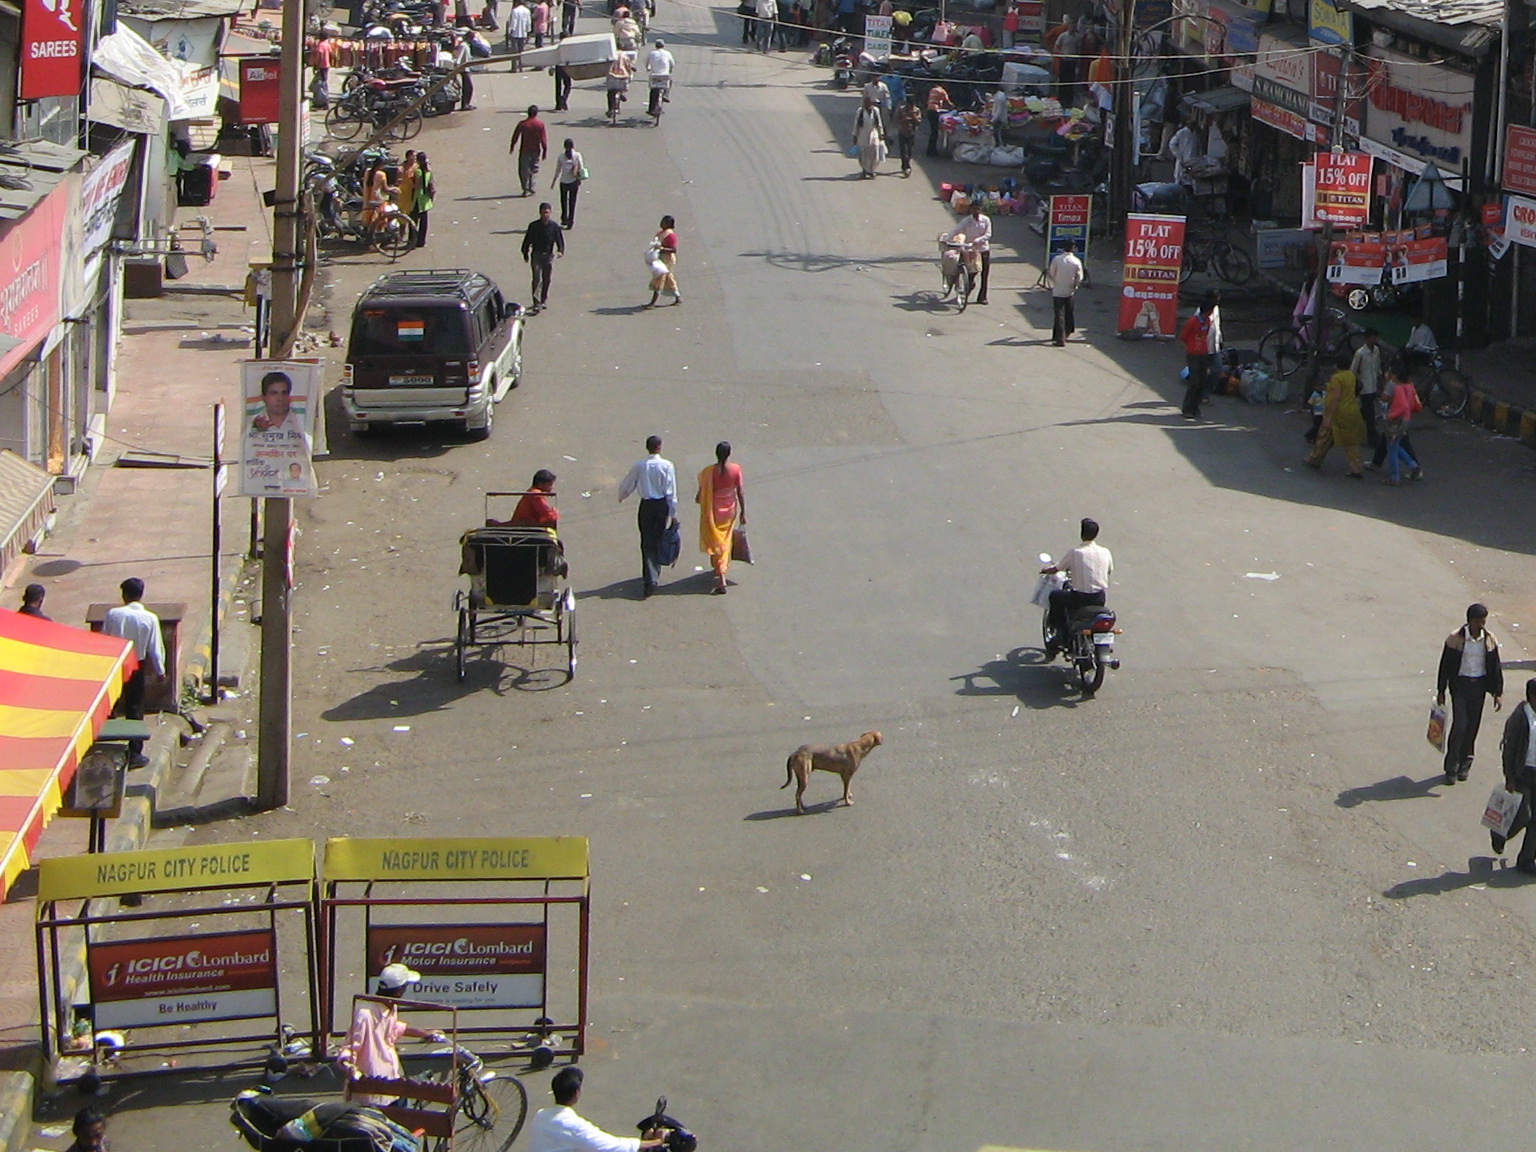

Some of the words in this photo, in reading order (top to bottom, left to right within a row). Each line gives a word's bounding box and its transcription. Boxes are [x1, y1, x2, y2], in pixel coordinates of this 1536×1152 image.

[30, 40, 78, 59] SAREES
[1330, 154, 1358, 167] FLAT
[1318, 168, 1347, 185] 15%
[1348, 172, 1368, 187] OFF
[1338, 195, 1364, 204] TITAN
[1140, 224, 1172, 238] FLAT
[1127, 239, 1158, 259] 15%
[1159, 245, 1181, 260] OFF
[1147, 270, 1176, 279] TITAN
[382, 850, 439, 871] NAGPUR
[445, 850, 477, 869] CITY
[481, 849, 530, 869] POLICE
[97, 862, 157, 884] NAGPUR
[163, 858, 196, 878] CITY
[200, 854, 251, 876] POLICE
[403, 942, 455, 955] ICICI
[469, 941, 533, 954] Lombard
[128, 957, 182, 974] ICICI
[202, 949, 270, 967] Lombard
[401, 955, 437, 966] Motor
[439, 956, 497, 966] Insurance
[125, 971, 165, 985] Health
[166, 968, 225, 982] Insurance
[413, 981, 450, 994] Drive
[454, 981, 499, 994] Safely
[158, 1004, 174, 1014] Be
[176, 1000, 218, 1013] Healthy
